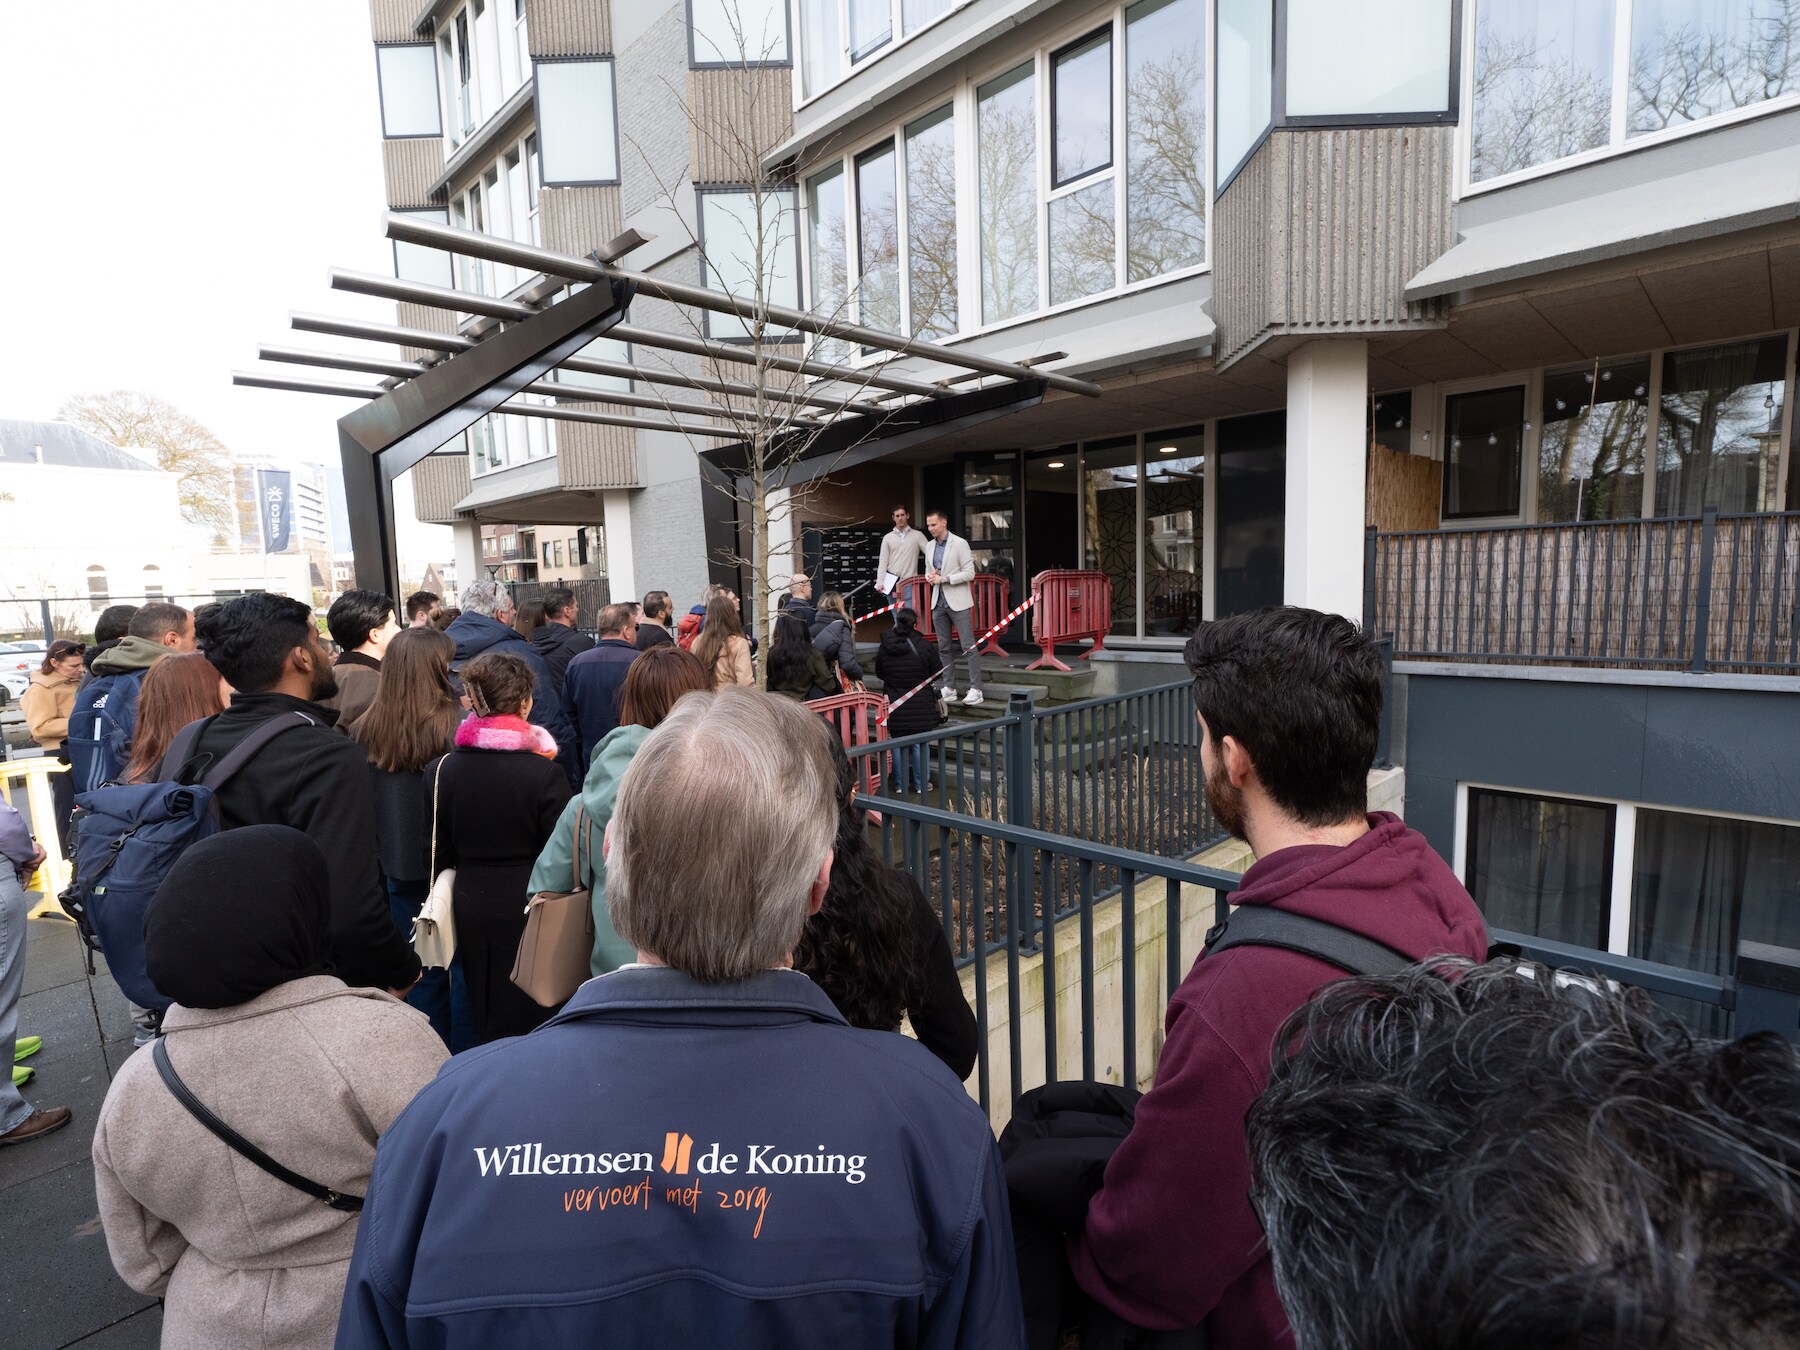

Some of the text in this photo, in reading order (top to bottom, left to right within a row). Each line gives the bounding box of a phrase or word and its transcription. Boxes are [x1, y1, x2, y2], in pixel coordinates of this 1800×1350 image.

[271, 503, 280, 539] SWECO
[474, 1143, 867, 1184] Willemsen de Koning
[564, 1176, 772, 1239] vervoert met zorg
